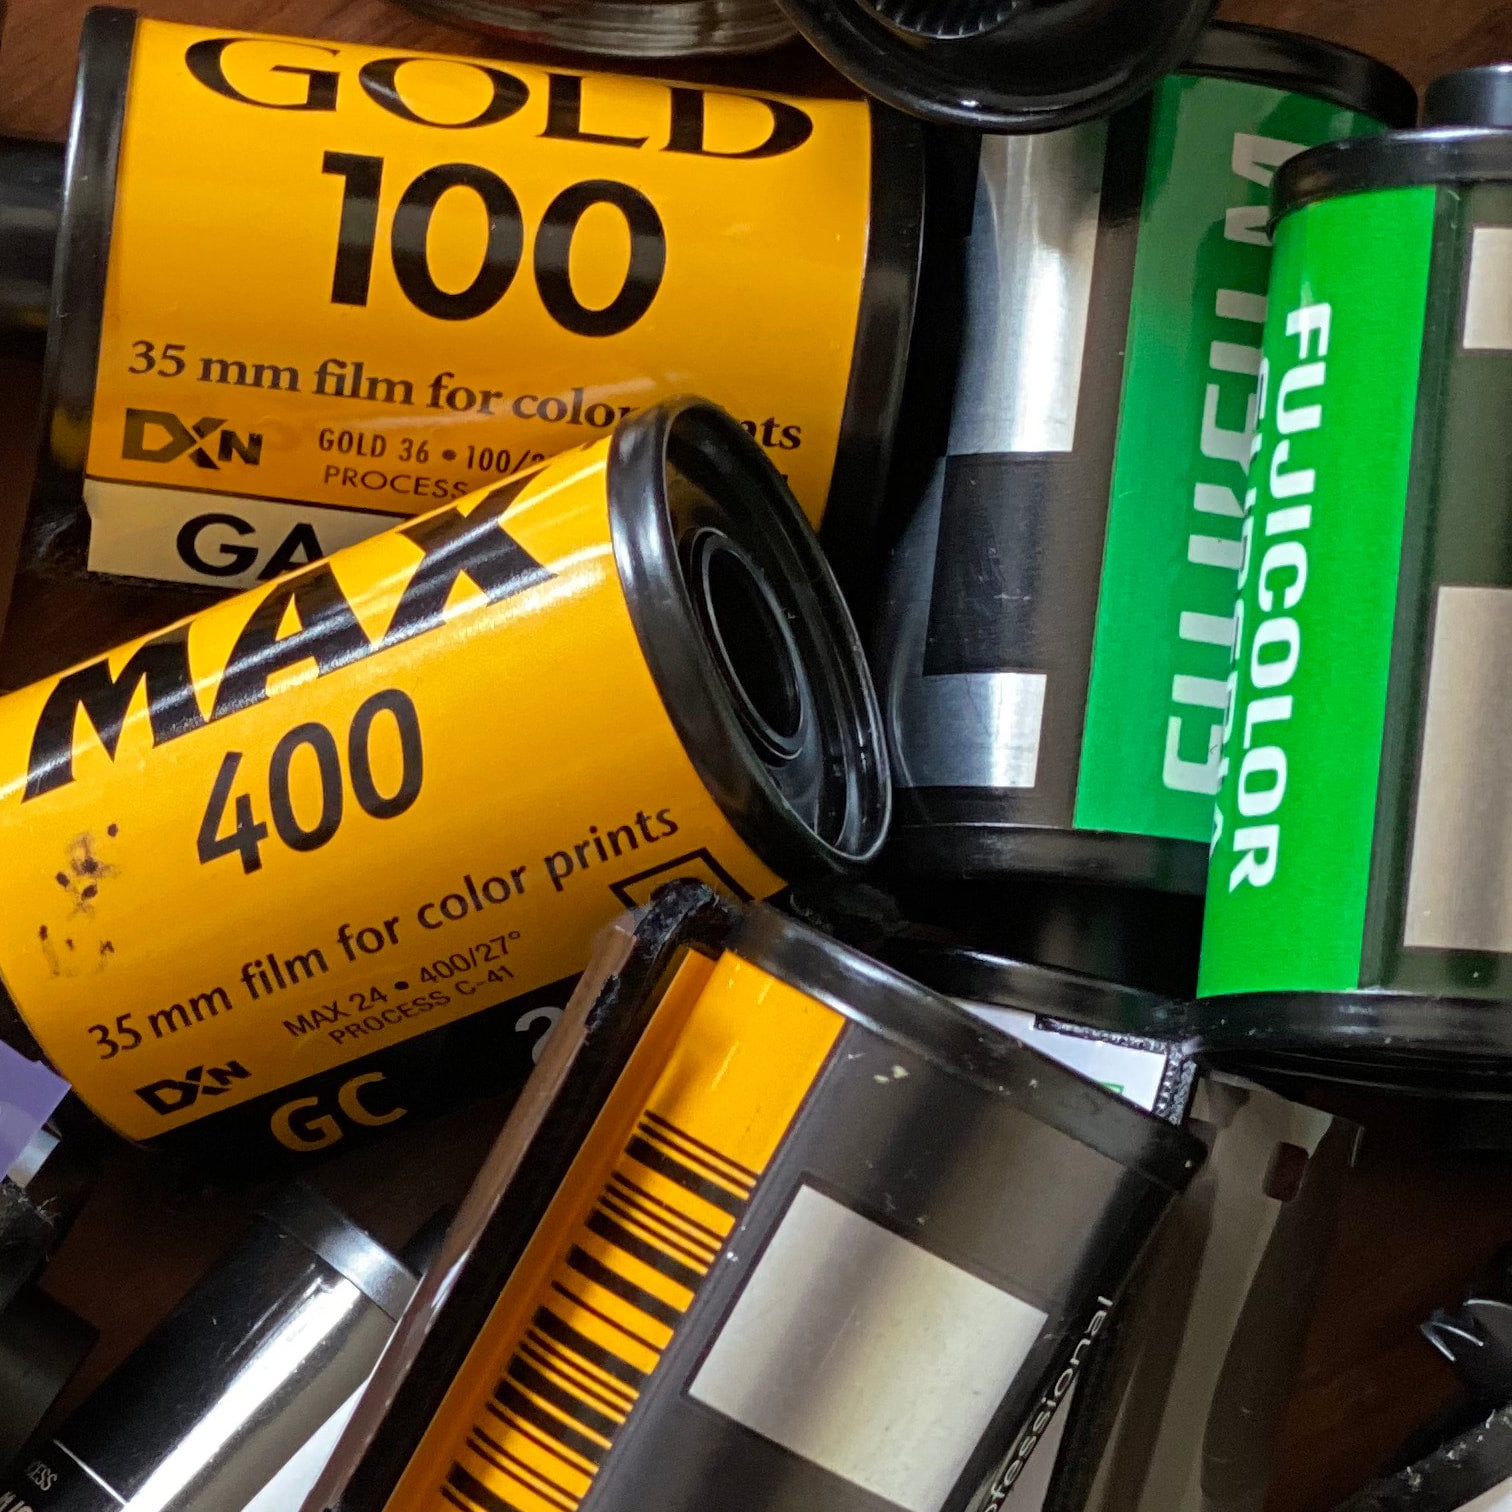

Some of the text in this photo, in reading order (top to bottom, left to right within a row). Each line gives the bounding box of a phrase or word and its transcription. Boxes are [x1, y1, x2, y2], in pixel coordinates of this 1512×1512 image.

[185, 37, 814, 159] GOLD
[322, 151, 666, 337] 100
[128, 340, 186, 378] 35
[197, 356, 301, 393] mm
[312, 358, 415, 406] film
[426, 372, 503, 416] for
[319, 428, 387, 458] GOLD
[398, 439, 429, 464] 36
[324, 464, 469, 499] PROCESS
[23, 463, 561, 802] MAX
[1228, 302, 1332, 894] FUJICOLOR
[197, 688, 424, 874] 400
[88, 807, 680, 1060] 35 mm film for color prints
[283, 930, 522, 1039] MAX 24 400/27°
[328, 966, 515, 1045] PROCESS C-41
[269, 1071, 408, 1152] GC
